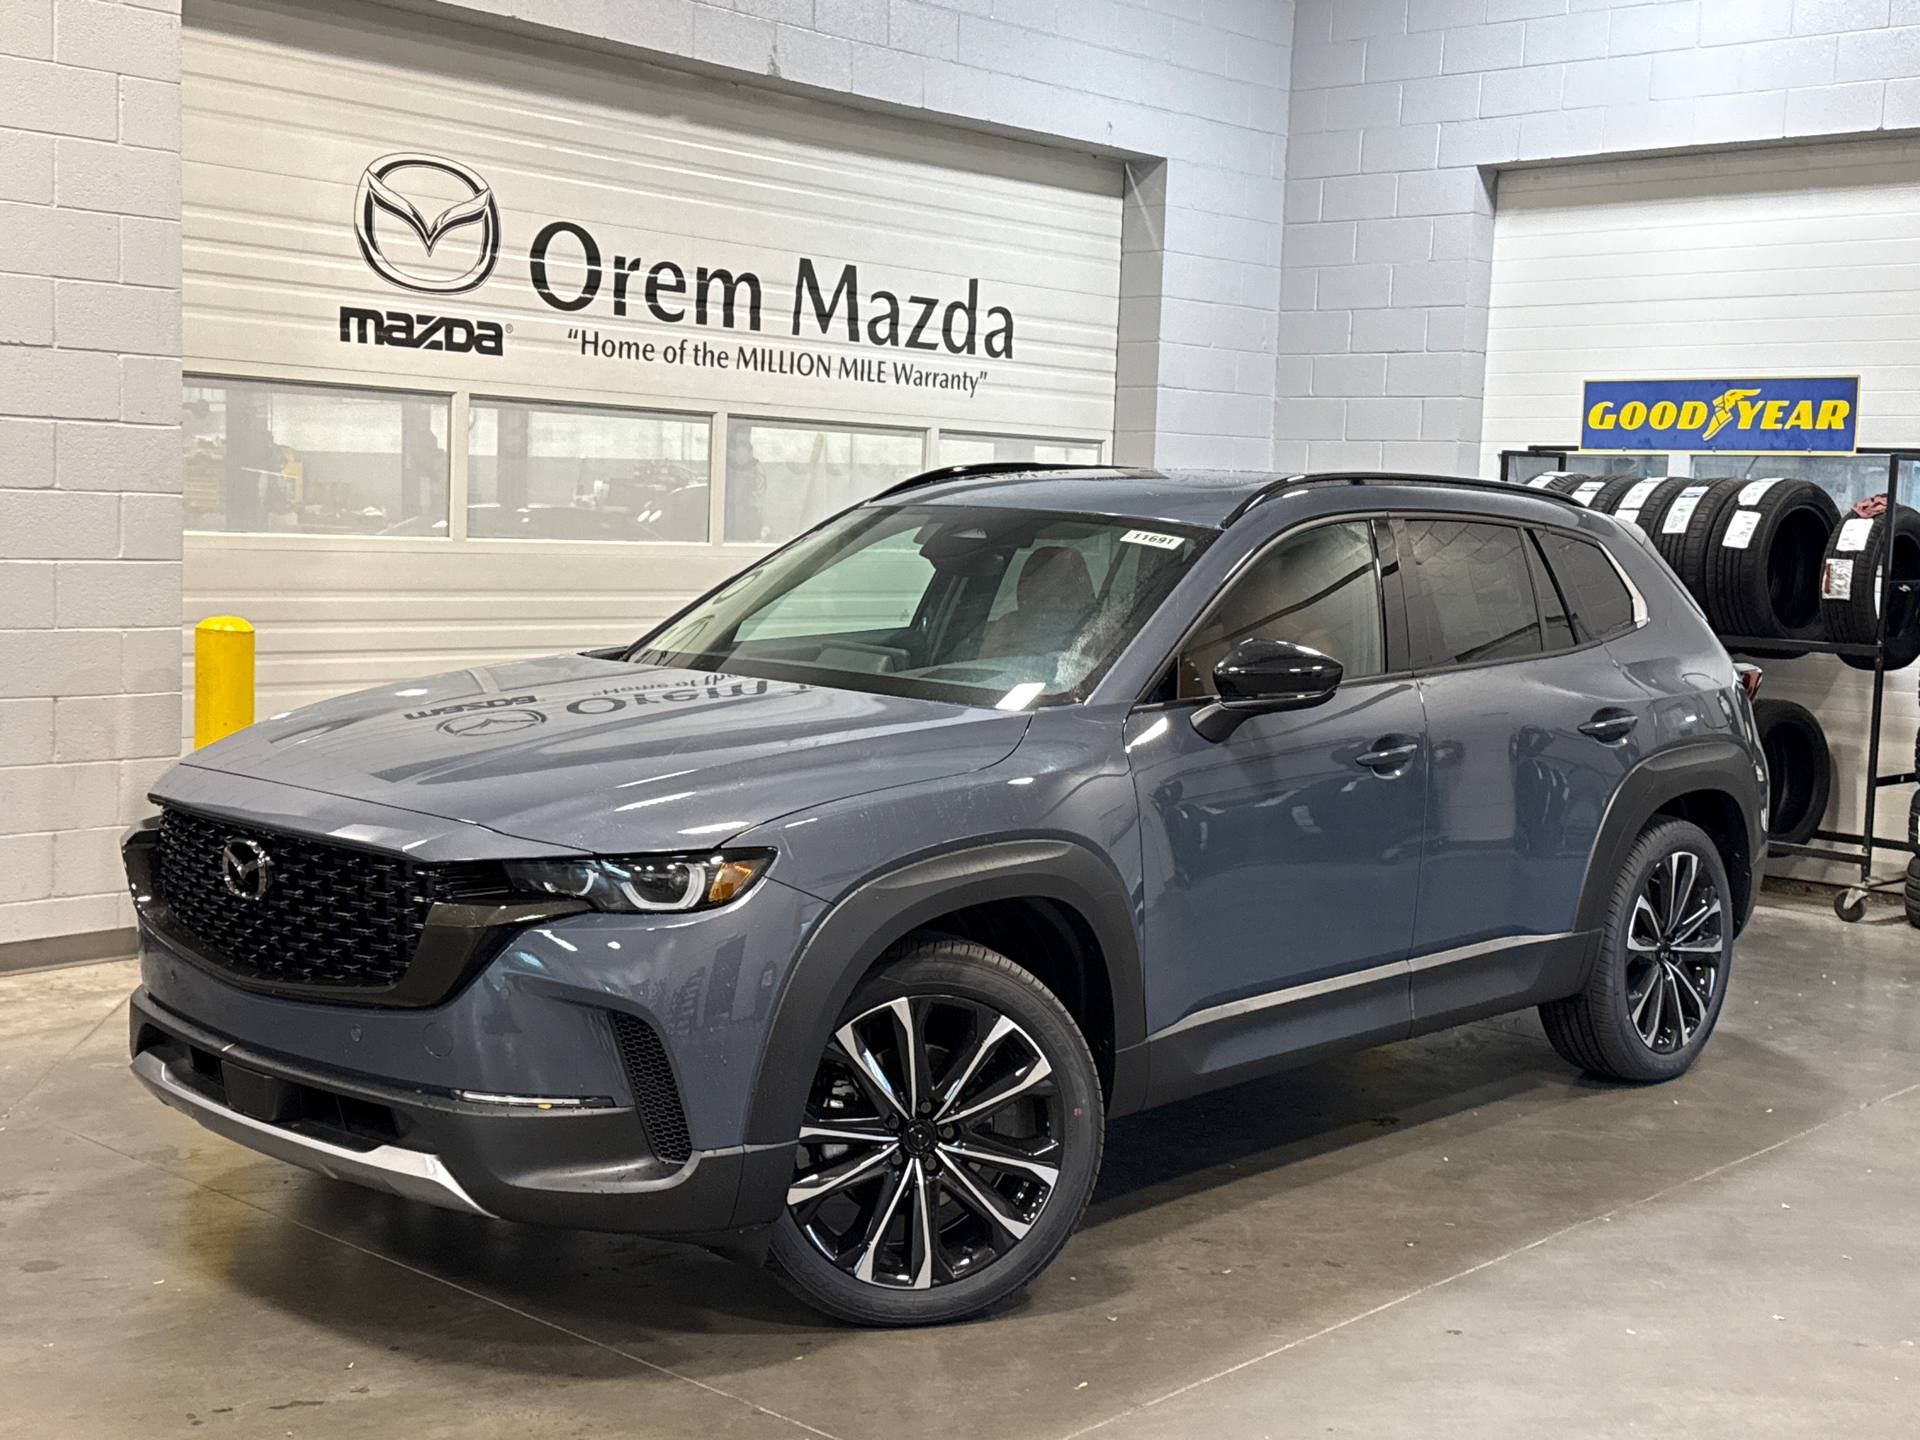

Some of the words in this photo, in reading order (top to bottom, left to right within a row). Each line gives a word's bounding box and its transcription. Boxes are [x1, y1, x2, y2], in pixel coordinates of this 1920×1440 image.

[530, 221, 762, 332] Orem
[792, 257, 1014, 359] Mazda
[567, 328, 655, 361] “Home
[663, 339, 688, 365] of
[693, 341, 729, 368] the
[736, 346, 832, 379] MILLION
[838, 357, 887, 383] MILE
[892, 361, 988, 398] Warranty”
[1133, 532, 1175, 545] 11691
